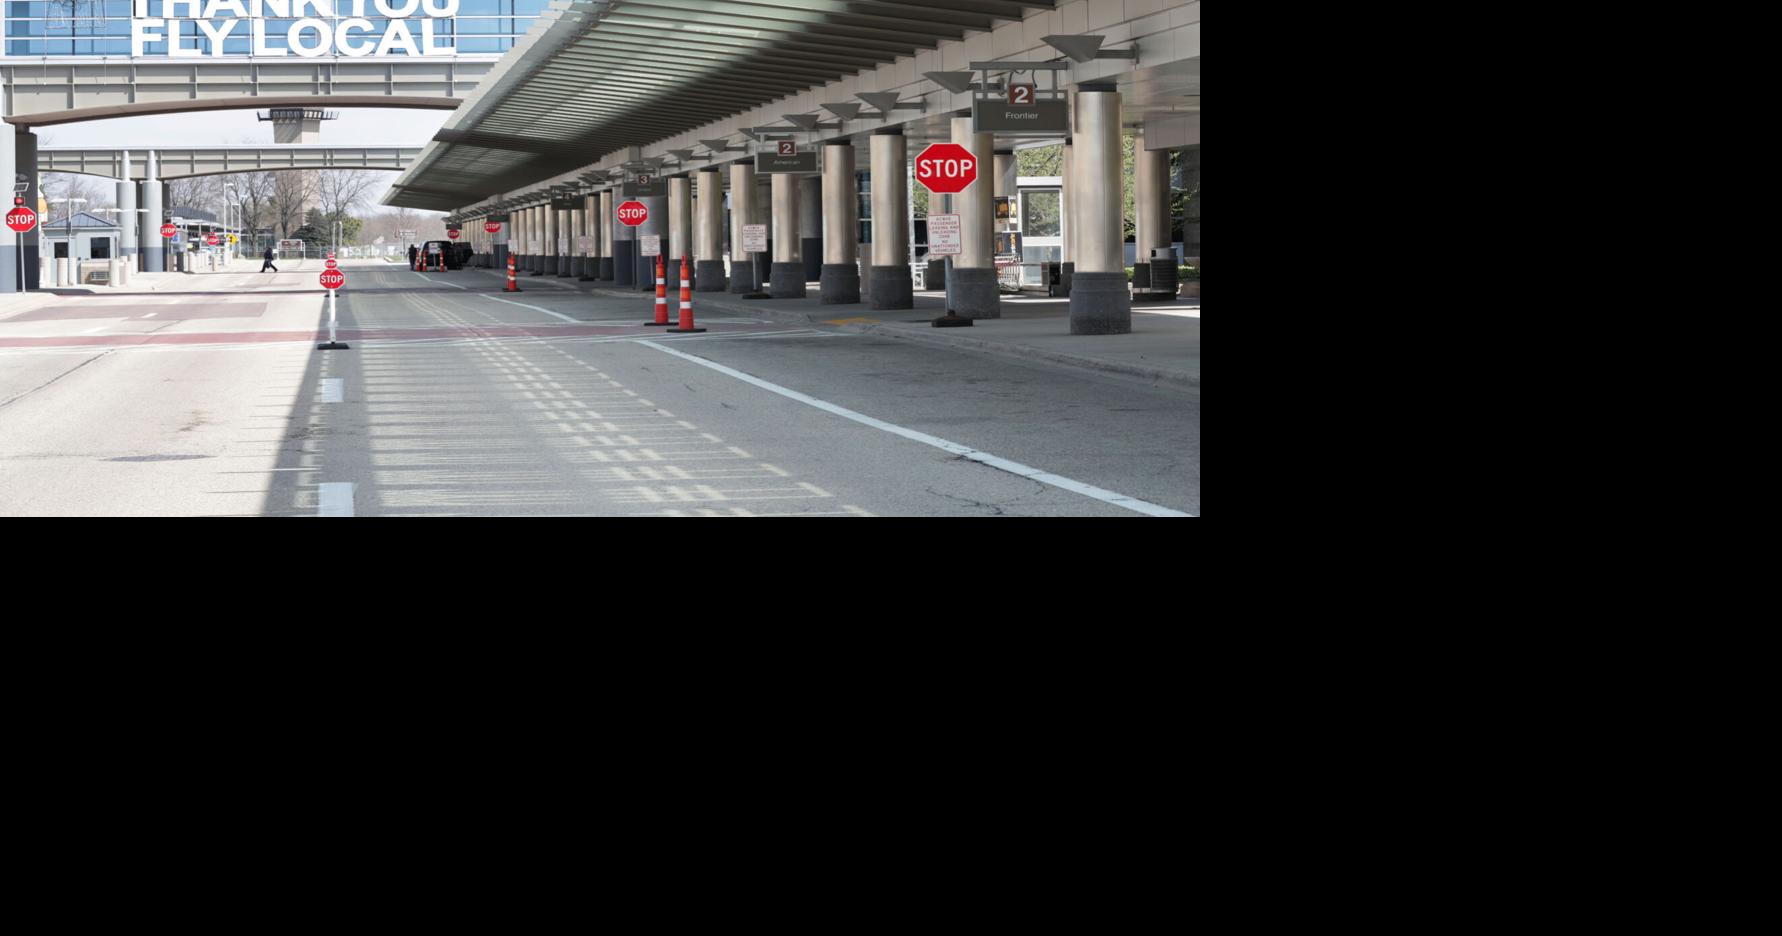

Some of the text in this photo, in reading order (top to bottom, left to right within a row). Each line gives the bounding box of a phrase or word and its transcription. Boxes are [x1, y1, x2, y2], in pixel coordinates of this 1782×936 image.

[132, 18, 456, 57] FLY LOCAL
[1014, 86, 1029, 104] 2
[1005, 112, 1039, 120] Frontier
[782, 143, 792, 154] 2
[919, 159, 973, 178] STOP
[640, 175, 648, 184] 3
[619, 208, 647, 219] STOP
[7, 214, 35, 225] STOP
[320, 275, 343, 283] STOP
